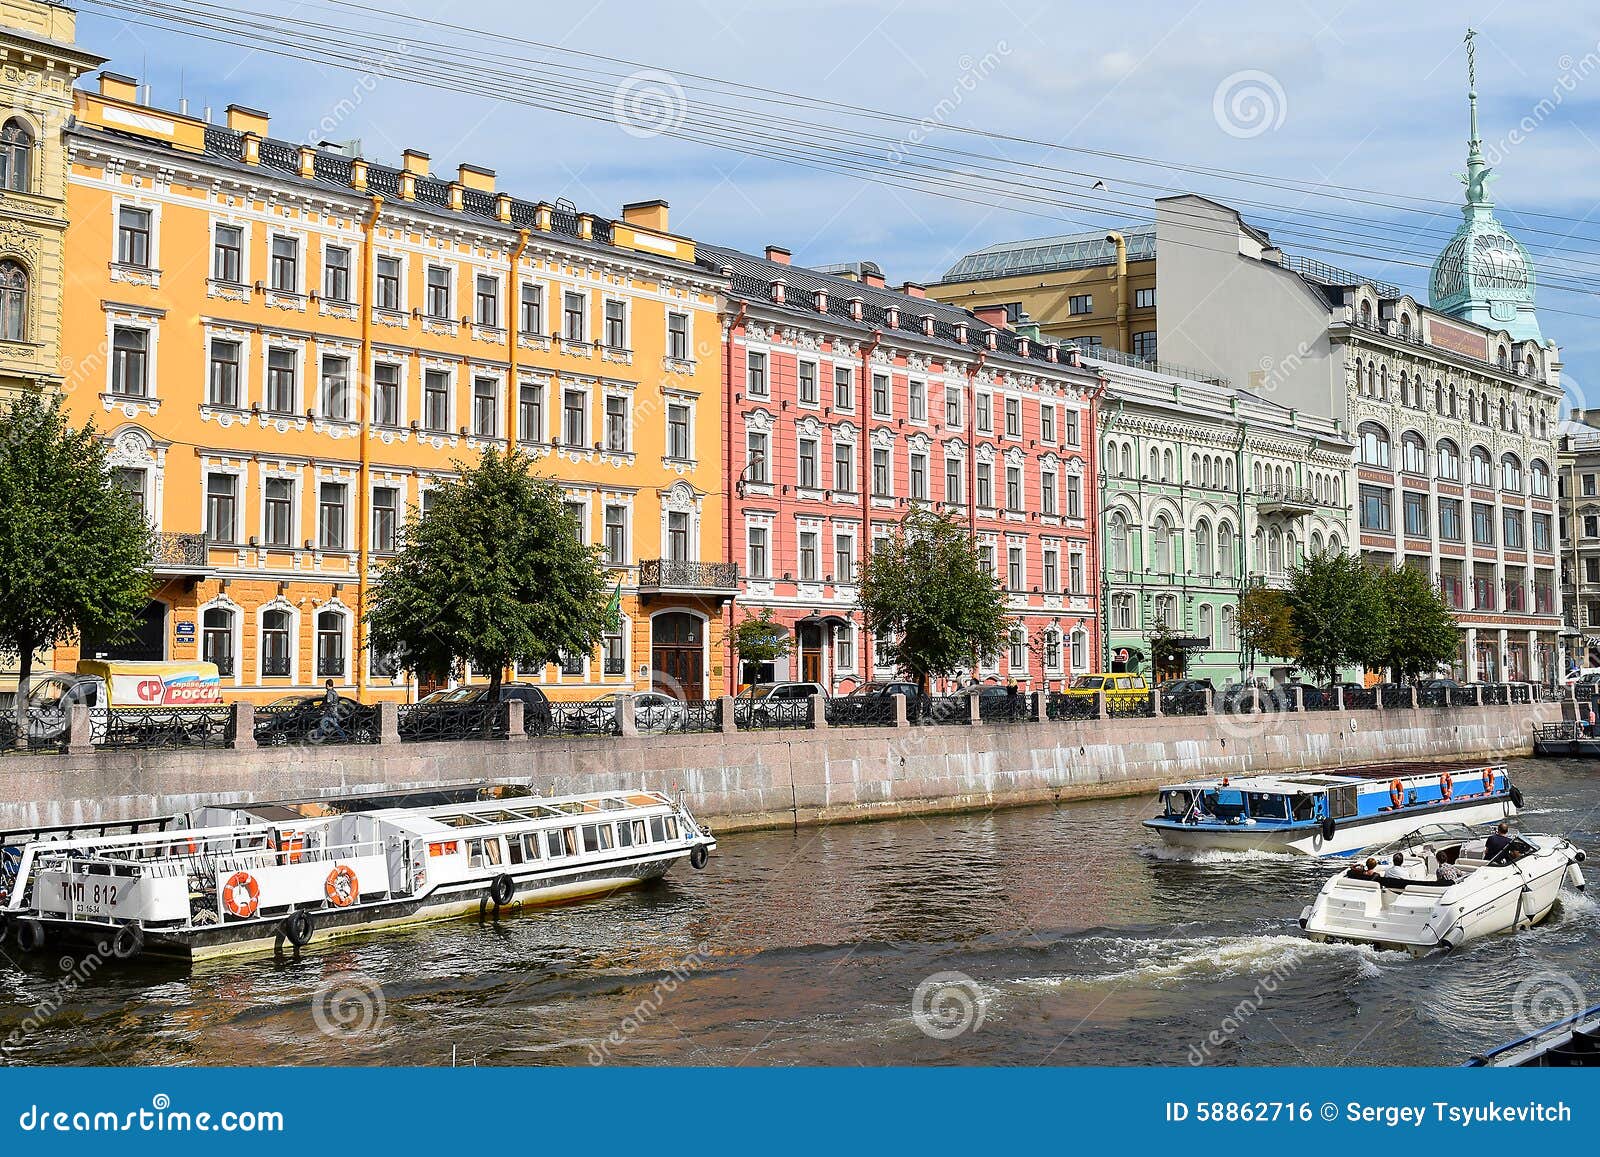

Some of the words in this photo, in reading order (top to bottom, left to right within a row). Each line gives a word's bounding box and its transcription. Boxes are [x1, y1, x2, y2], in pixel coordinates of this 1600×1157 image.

[137, 680, 161, 701] СР
[61, 882, 85, 902] ТОП
[93, 884, 117, 905] 812
